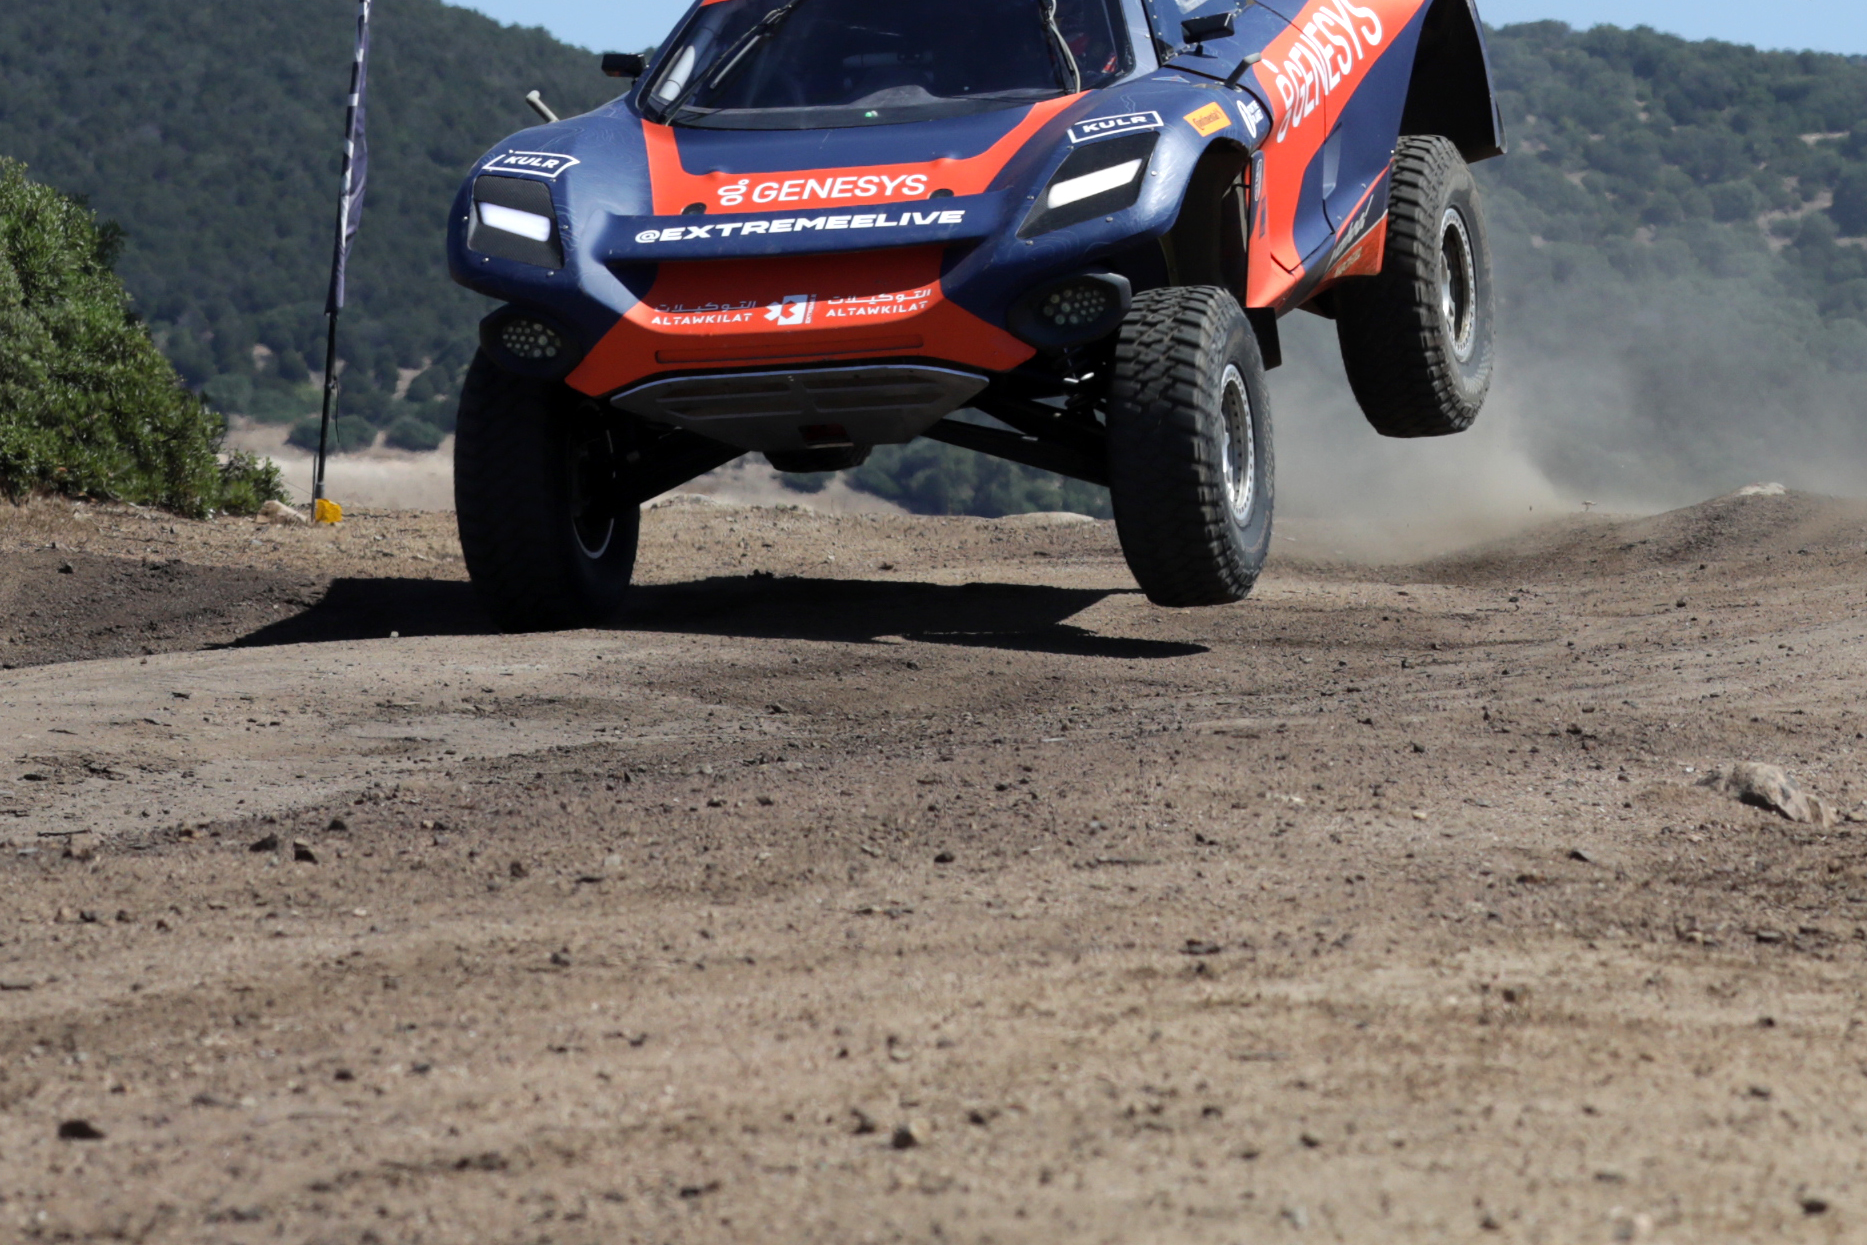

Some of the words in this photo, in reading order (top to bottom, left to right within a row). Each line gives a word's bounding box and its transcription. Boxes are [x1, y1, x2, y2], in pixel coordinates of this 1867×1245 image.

[1082, 115, 1149, 133] KULR
[503, 156, 560, 168] KULR
[751, 174, 928, 204] GENESYS
[634, 209, 966, 244] @EXTREMEELIVE
[825, 300, 928, 318] ALTAWKILAT
[651, 313, 754, 326] ALTAWKILAT
